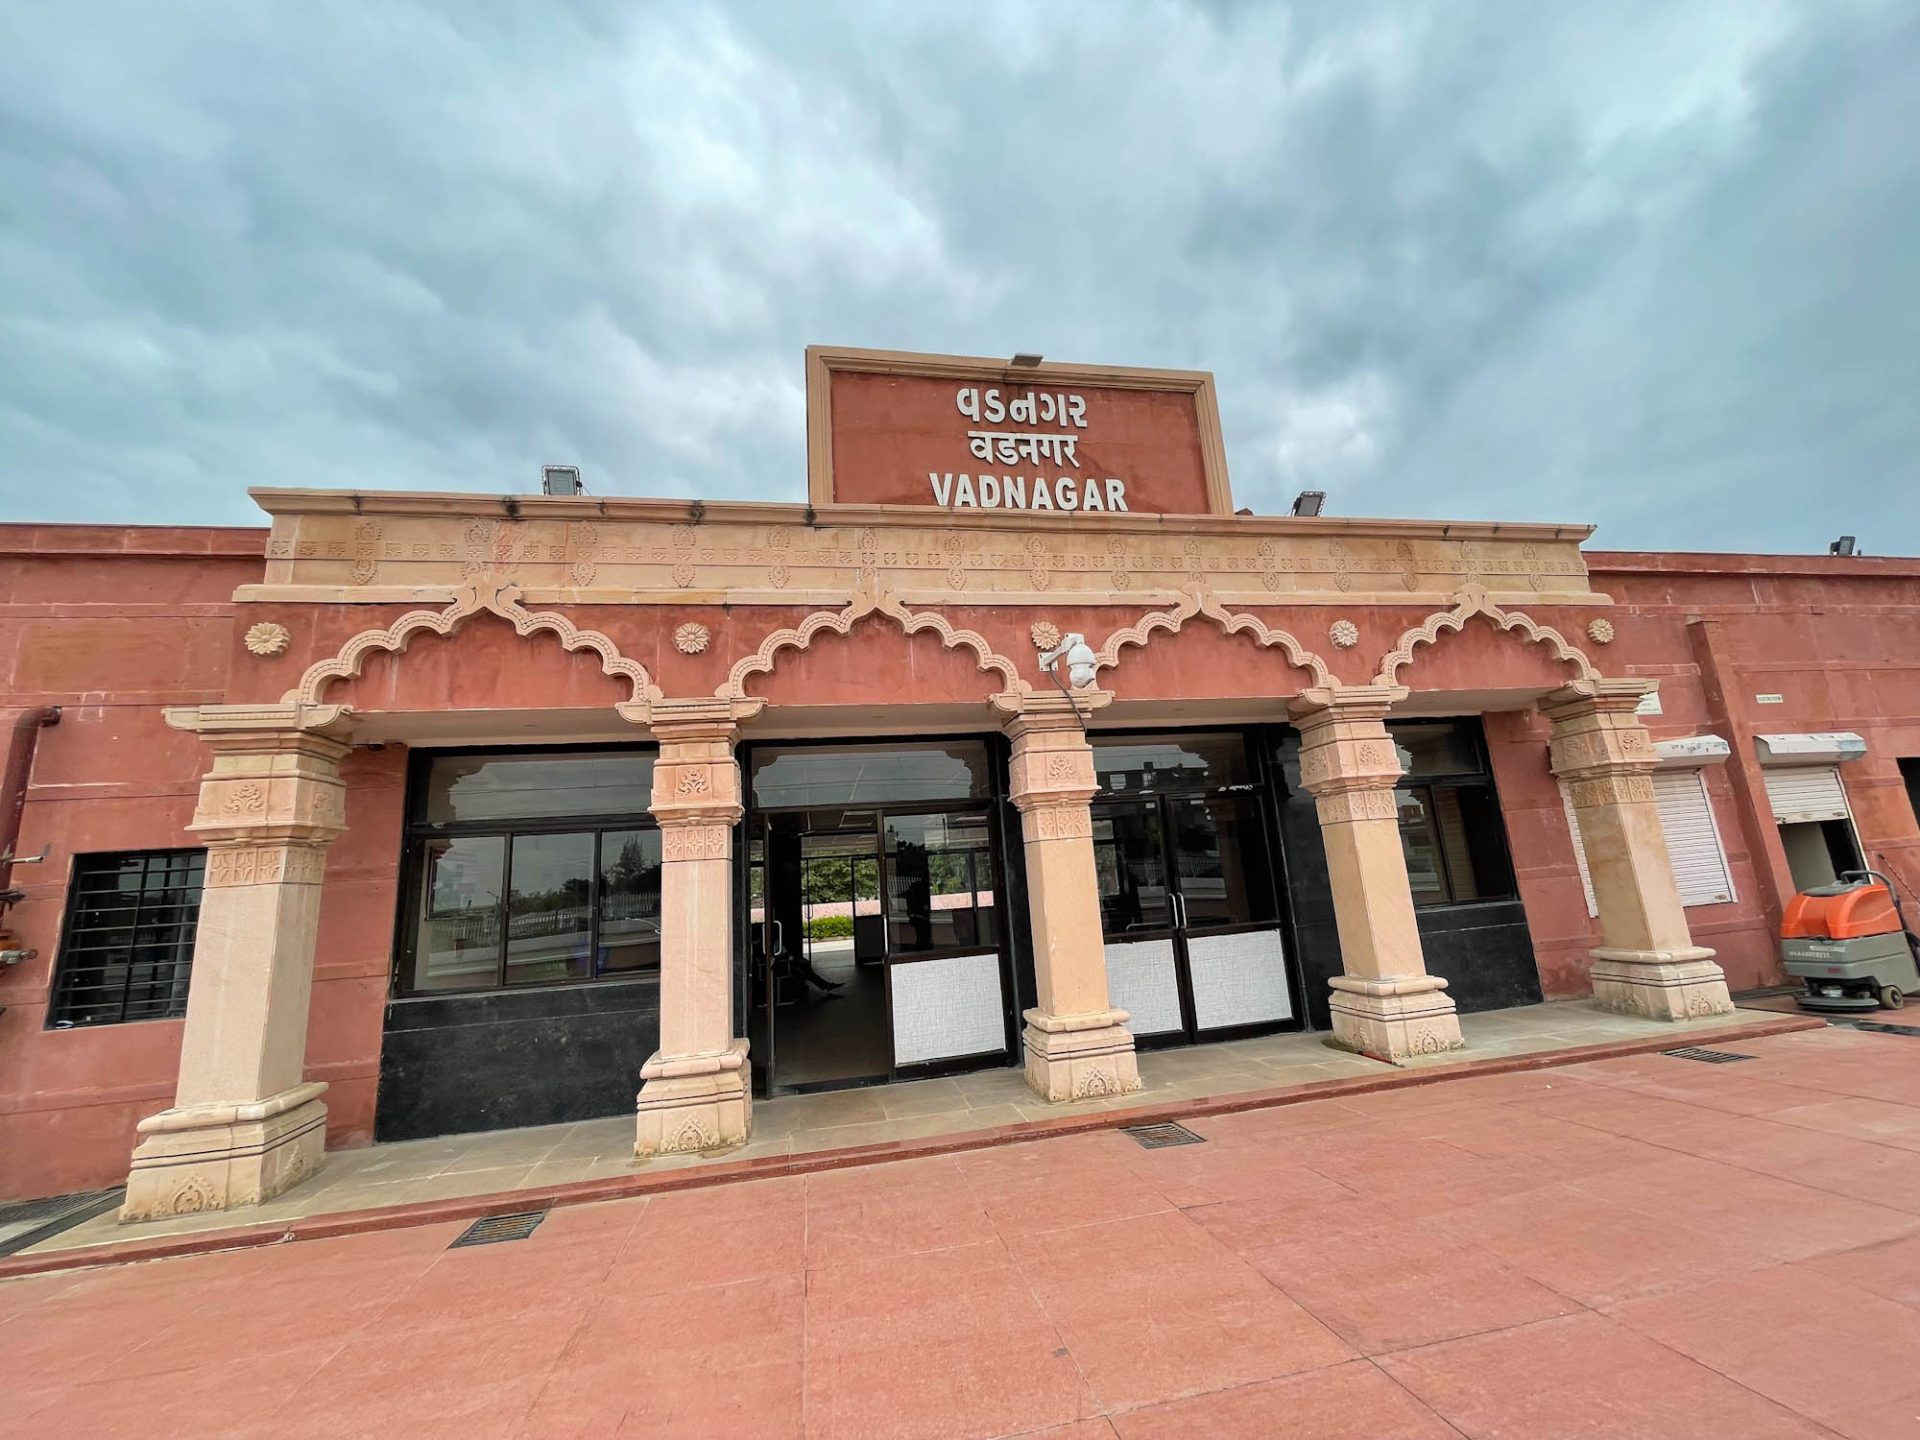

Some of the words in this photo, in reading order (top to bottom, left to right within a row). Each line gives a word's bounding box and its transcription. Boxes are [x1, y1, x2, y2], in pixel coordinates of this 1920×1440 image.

[956, 387, 1088, 428] વડનગર
[967, 430, 1079, 468] वडनगर
[928, 472, 1129, 512] VADNAGAR
